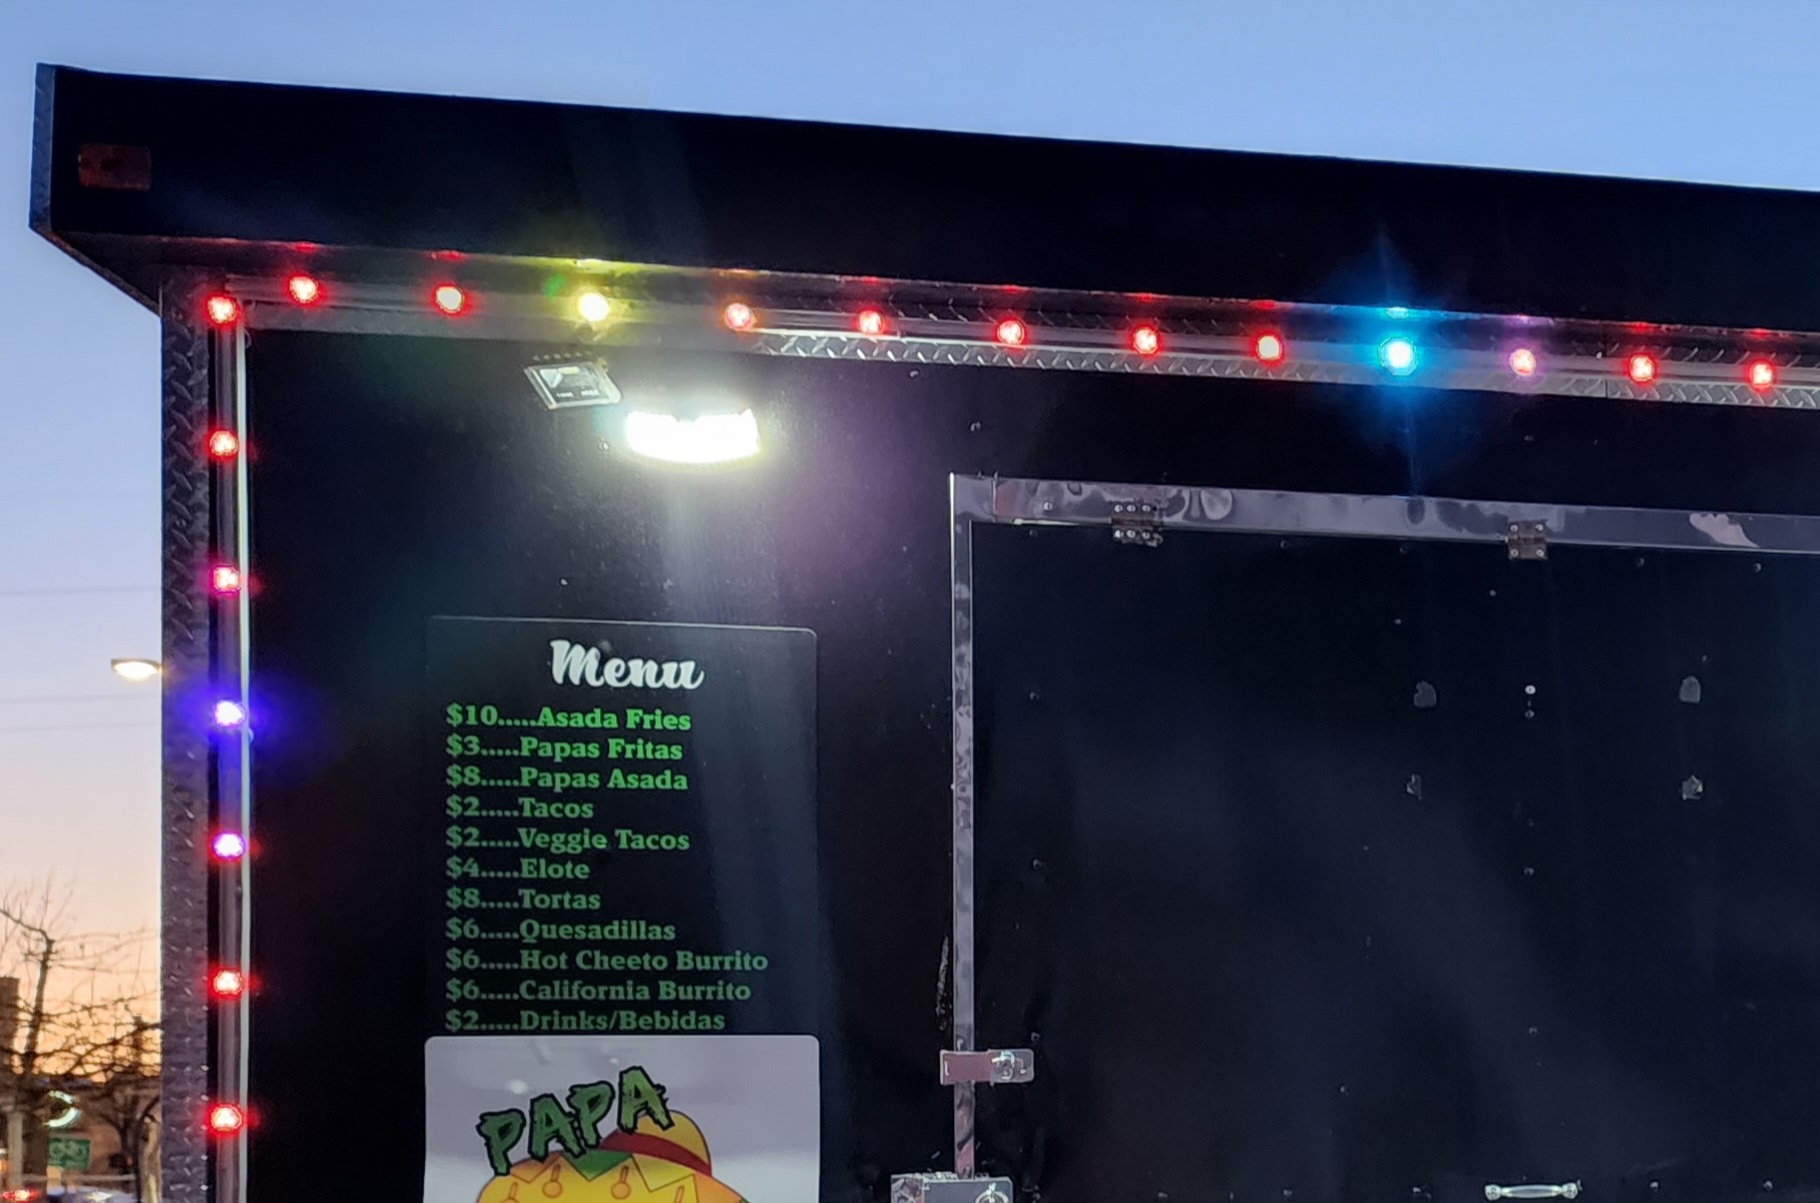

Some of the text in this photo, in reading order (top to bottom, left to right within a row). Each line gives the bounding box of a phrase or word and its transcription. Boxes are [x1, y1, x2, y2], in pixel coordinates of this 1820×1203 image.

[550, 640, 704, 689] Menu
[626, 709, 691, 730] Fries
[607, 739, 682, 760] Fritas
[607, 769, 688, 790] Asada
[615, 830, 690, 850] Tacos
[575, 951, 668, 971] Cheeto
[676, 951, 768, 972] Burrito
[658, 982, 751, 1001] Burrito
[476, 1066, 675, 1175] PAPA
